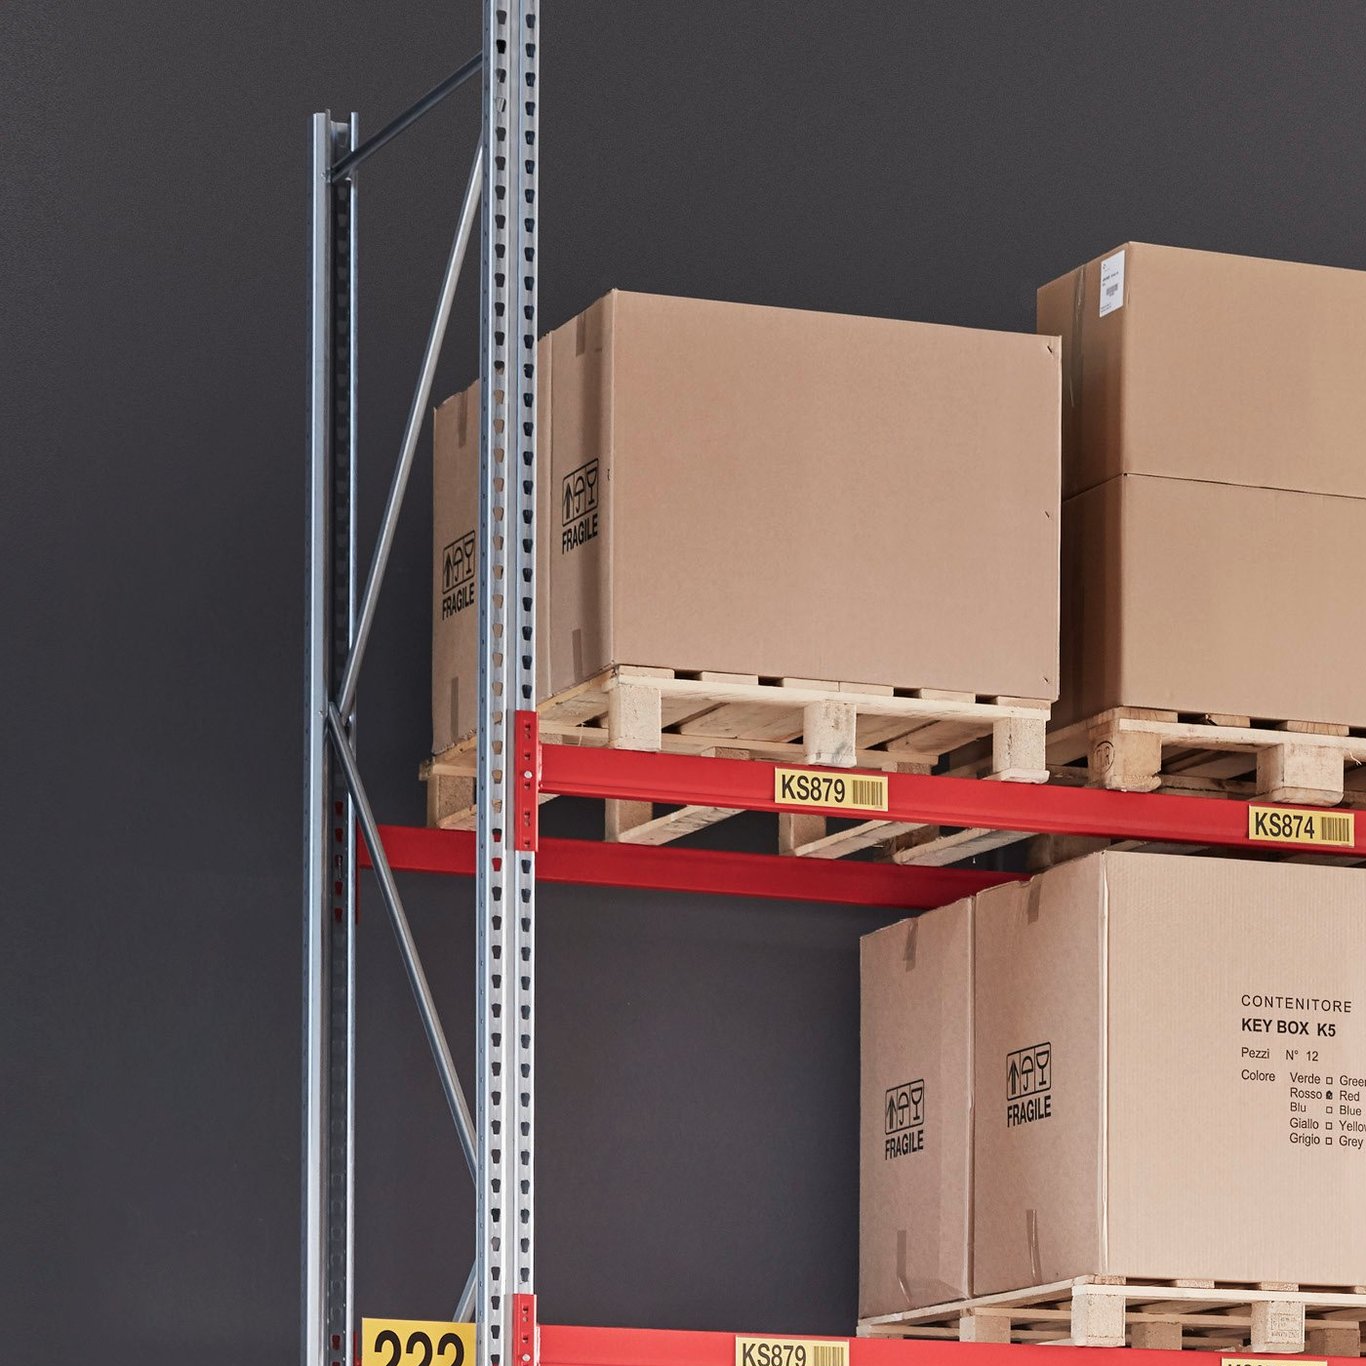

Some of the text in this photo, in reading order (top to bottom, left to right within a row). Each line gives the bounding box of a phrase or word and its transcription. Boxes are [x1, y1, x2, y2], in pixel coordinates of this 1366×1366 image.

[562, 513, 598, 555] FRAGILE
[442, 582, 474, 620] FRAGILE
[782, 774, 845, 803] KS879
[1255, 812, 1314, 839] KS874
[1241, 994, 1352, 1012] CONTENITORE
[1242, 1018, 1336, 1037] KEY BOX K5
[1241, 1047, 1270, 1059] Pezzi
[1306, 1051, 1318, 1061] 12
[1241, 1069, 1275, 1081] Colore
[1290, 1072, 1320, 1084] Verde
[1290, 1087, 1360, 1101] Rosso Red
[1007, 1095, 1051, 1128] FRAGILE
[1290, 1102, 1362, 1116] Blu Blue
[1290, 1118, 1319, 1129] Giallo
[885, 1129, 923, 1160] FRAGILE
[1290, 1133, 1363, 1149] Grigio Grey
